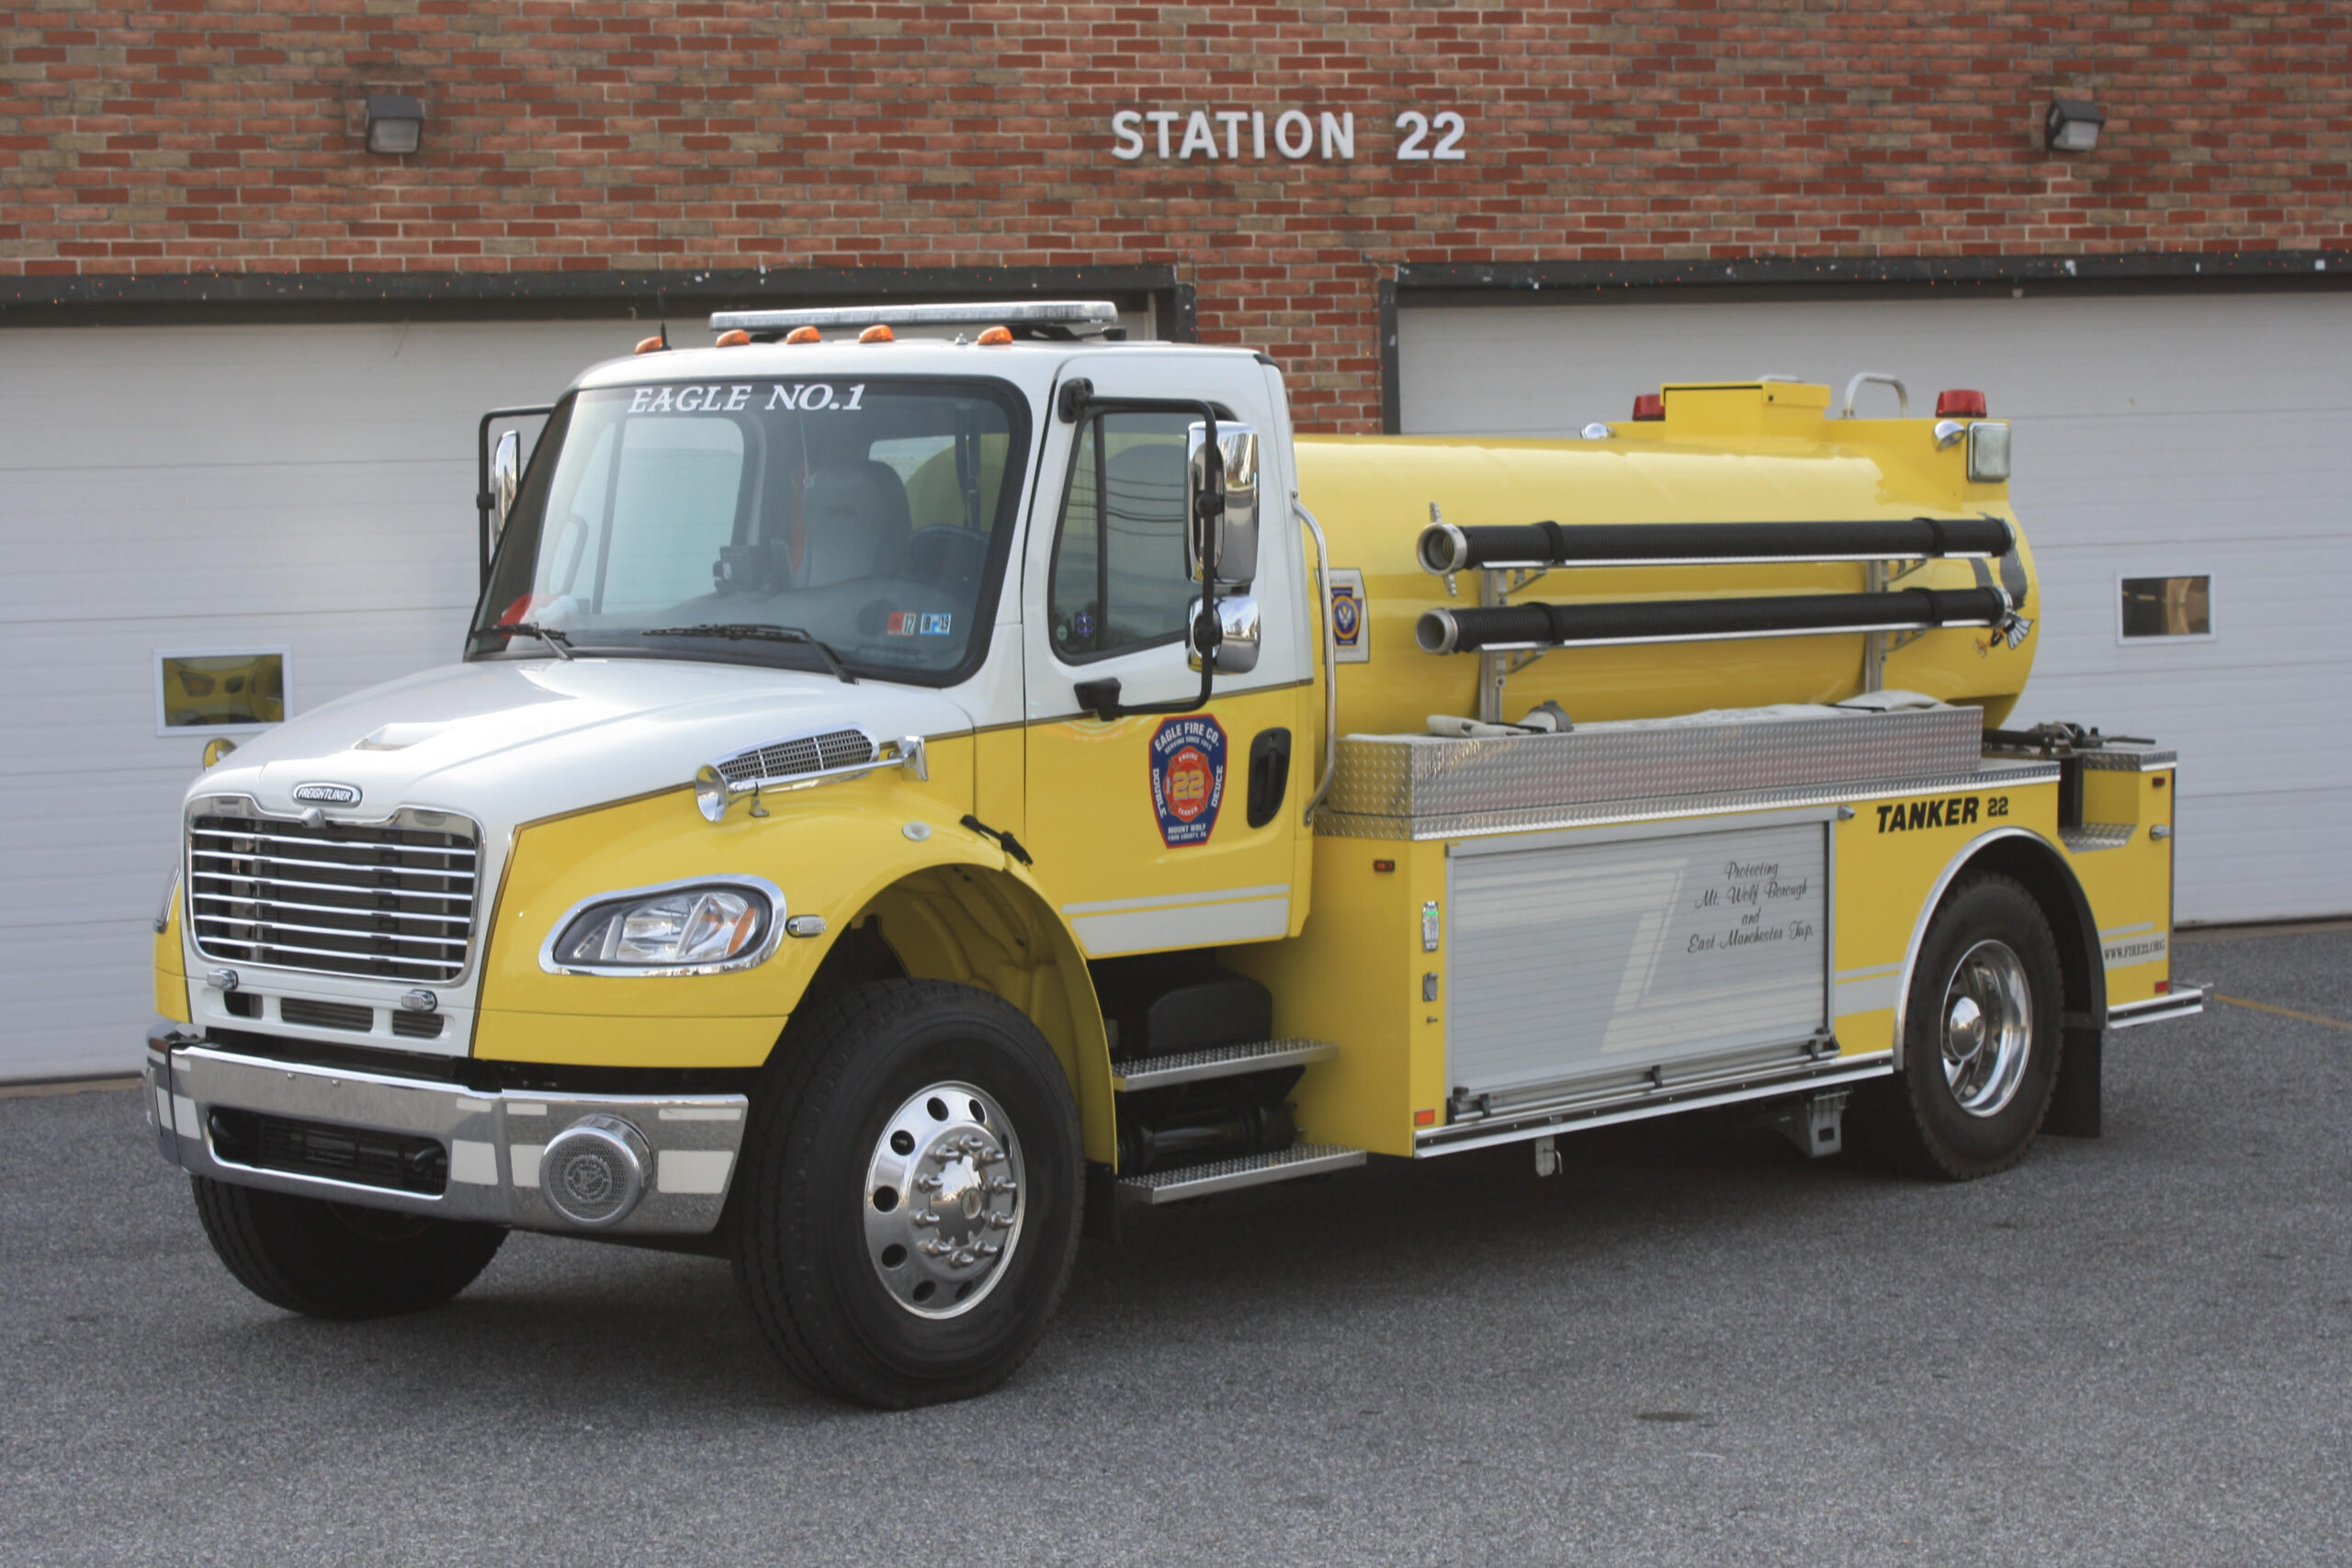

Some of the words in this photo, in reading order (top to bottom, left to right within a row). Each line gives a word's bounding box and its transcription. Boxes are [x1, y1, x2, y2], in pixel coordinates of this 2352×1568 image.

[1111, 109, 1355, 160] STATION
[1395, 110, 1466, 160] 22
[627, 384, 752, 413] EAGLE
[764, 383, 865, 412] NO.1
[1155, 723, 1182, 752] EAGLE
[1184, 721, 1204, 737] FIRE
[1205, 727, 1219, 748] CO.
[298, 787, 352, 802] FREIGHTLINER
[1152, 767, 1167, 818] DOUBLE
[1172, 769, 1205, 800] 22
[1211, 764, 1224, 808] DEUCE
[1168, 825, 1189, 835] MOUNT
[1190, 822, 1207, 832] WOLF
[1876, 795, 1980, 834] TANKER
[1987, 795, 2008, 817] 22
[1724, 862, 1779, 880] Protecting
[1694, 889, 1720, 909] Mt.
[1726, 883, 1759, 906] Wolf
[1764, 877, 1808, 901] Borough
[1741, 907, 1761, 926] and
[1687, 933, 1715, 953] East
[1720, 926, 1783, 950] Manchester
[1788, 920, 1815, 942] Twp.
